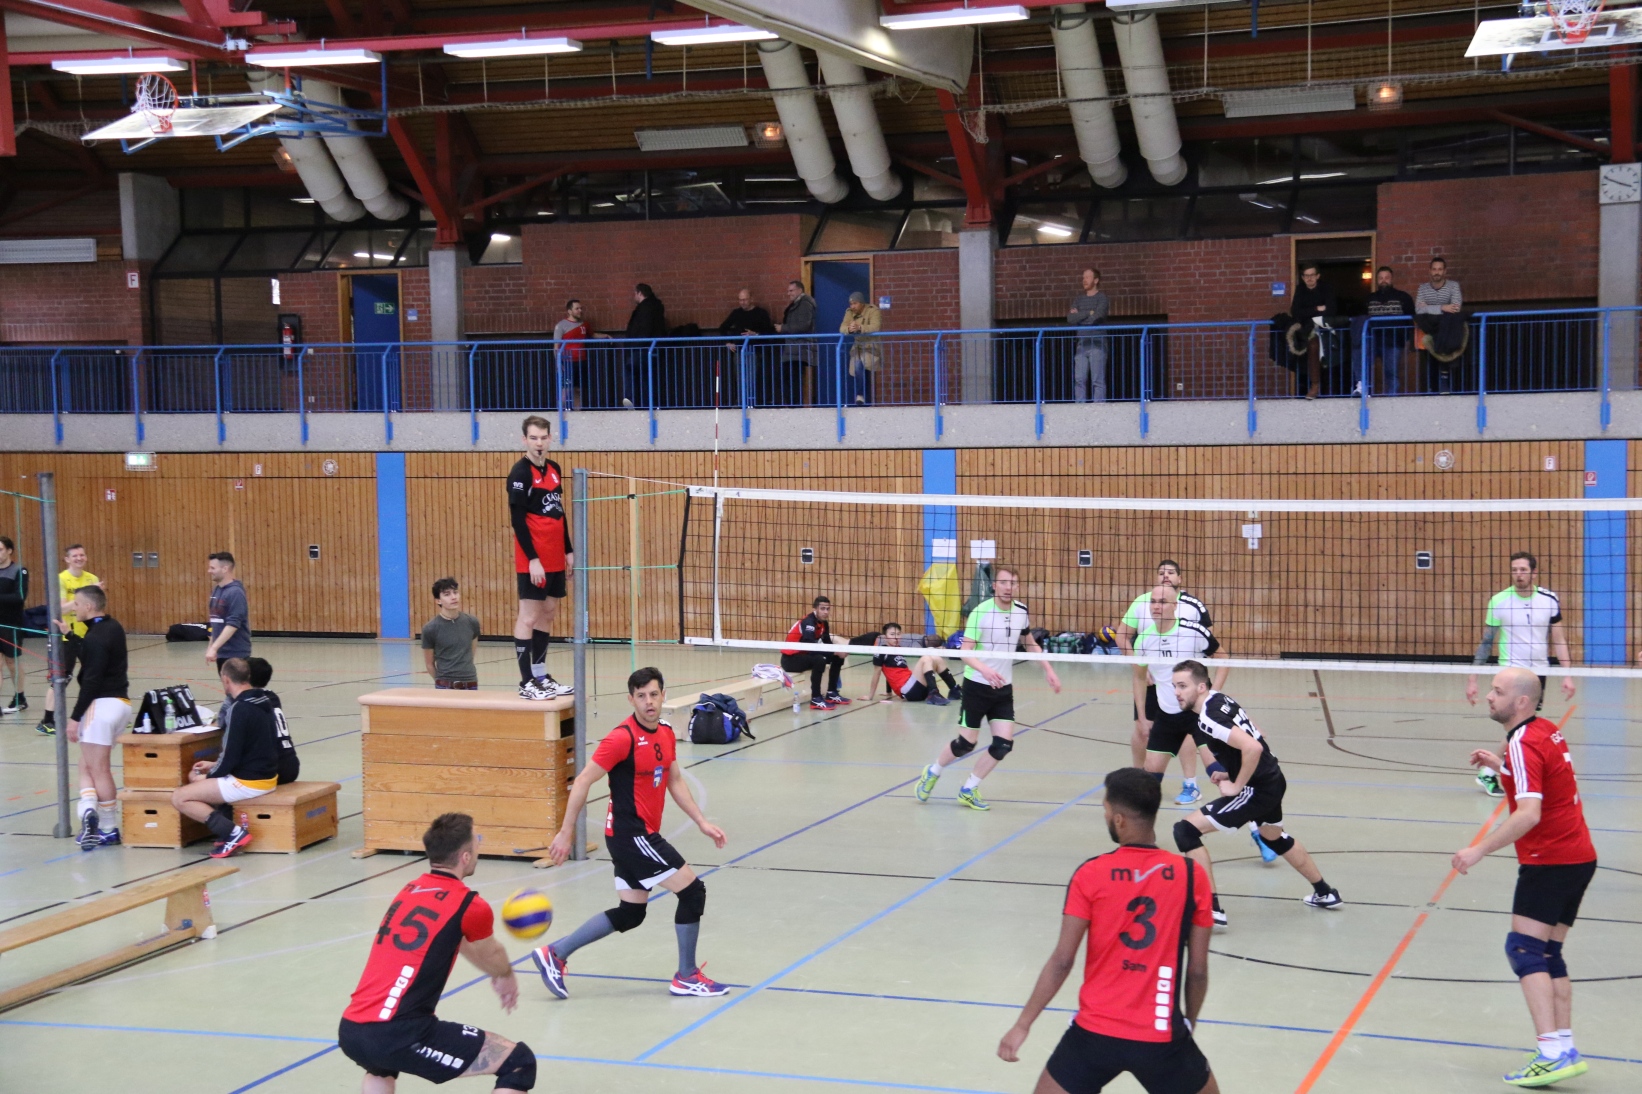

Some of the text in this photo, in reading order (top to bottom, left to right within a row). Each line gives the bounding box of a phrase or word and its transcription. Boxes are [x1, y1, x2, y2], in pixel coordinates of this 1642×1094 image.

[130, 274, 137, 286] F
[653, 742, 663, 761] 8
[376, 900, 441, 952] 45
[1119, 895, 1157, 950] 3
[462, 1024, 479, 1037] 13
